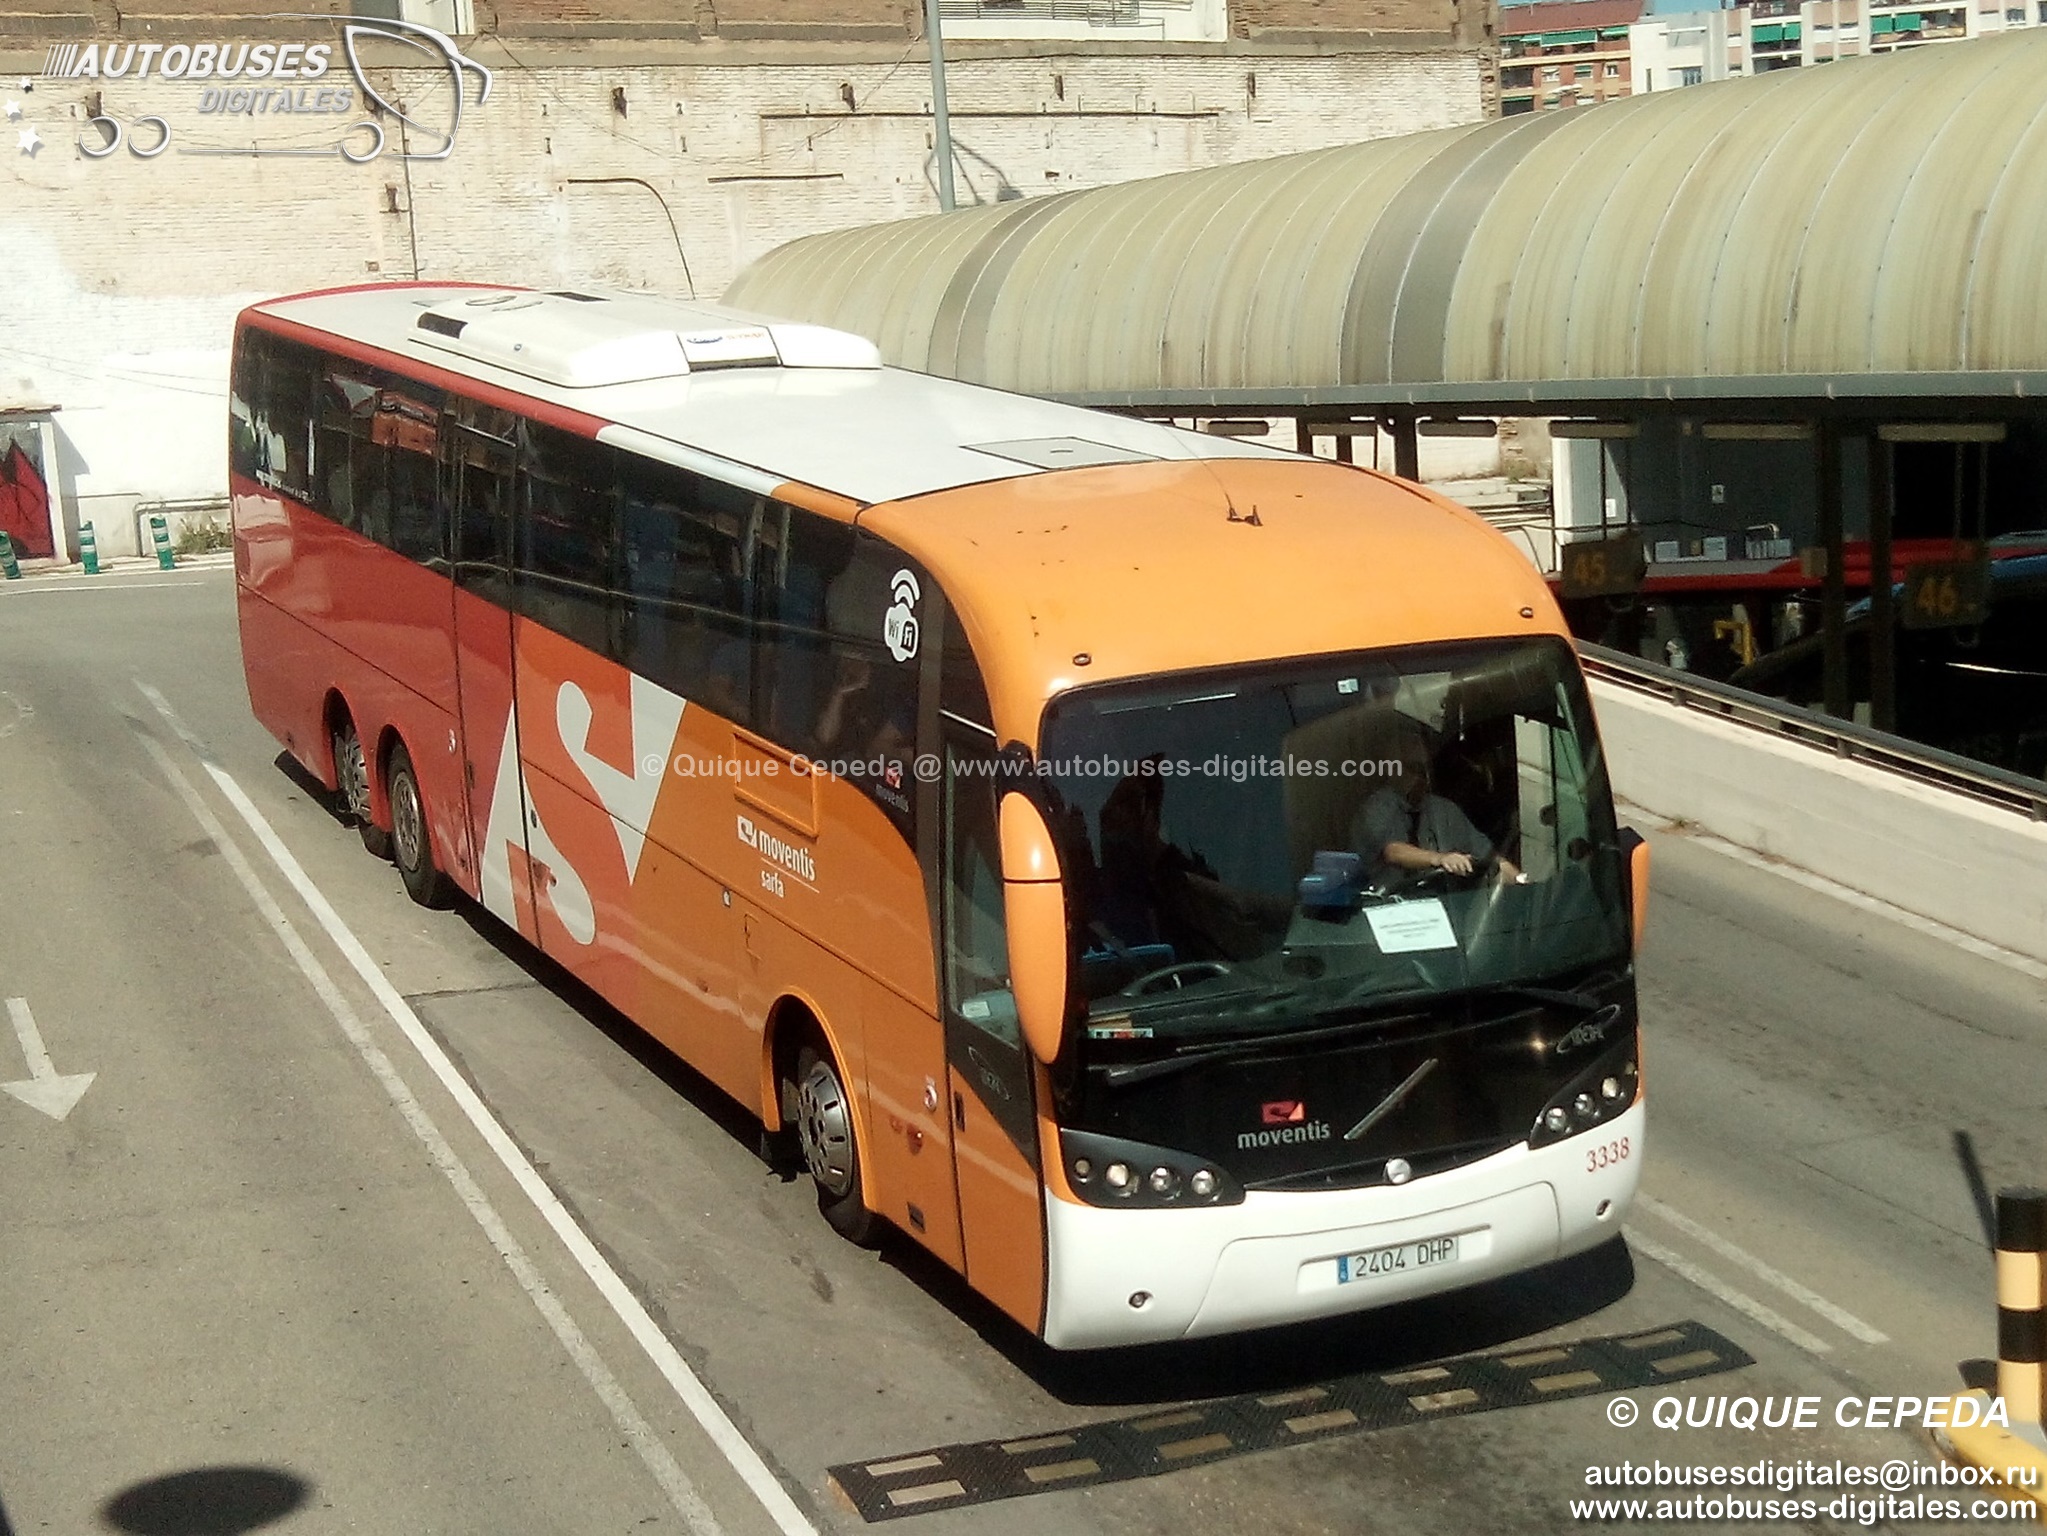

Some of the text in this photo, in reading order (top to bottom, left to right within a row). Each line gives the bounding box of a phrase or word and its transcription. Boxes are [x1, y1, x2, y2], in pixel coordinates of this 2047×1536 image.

[759, 829, 817, 882] moventis
[1237, 1119, 1331, 1150] moventis
[1586, 1136, 1630, 1173] 3338
[1355, 1248, 1406, 1278] 2404
[1417, 1238, 1454, 1265] DHP
